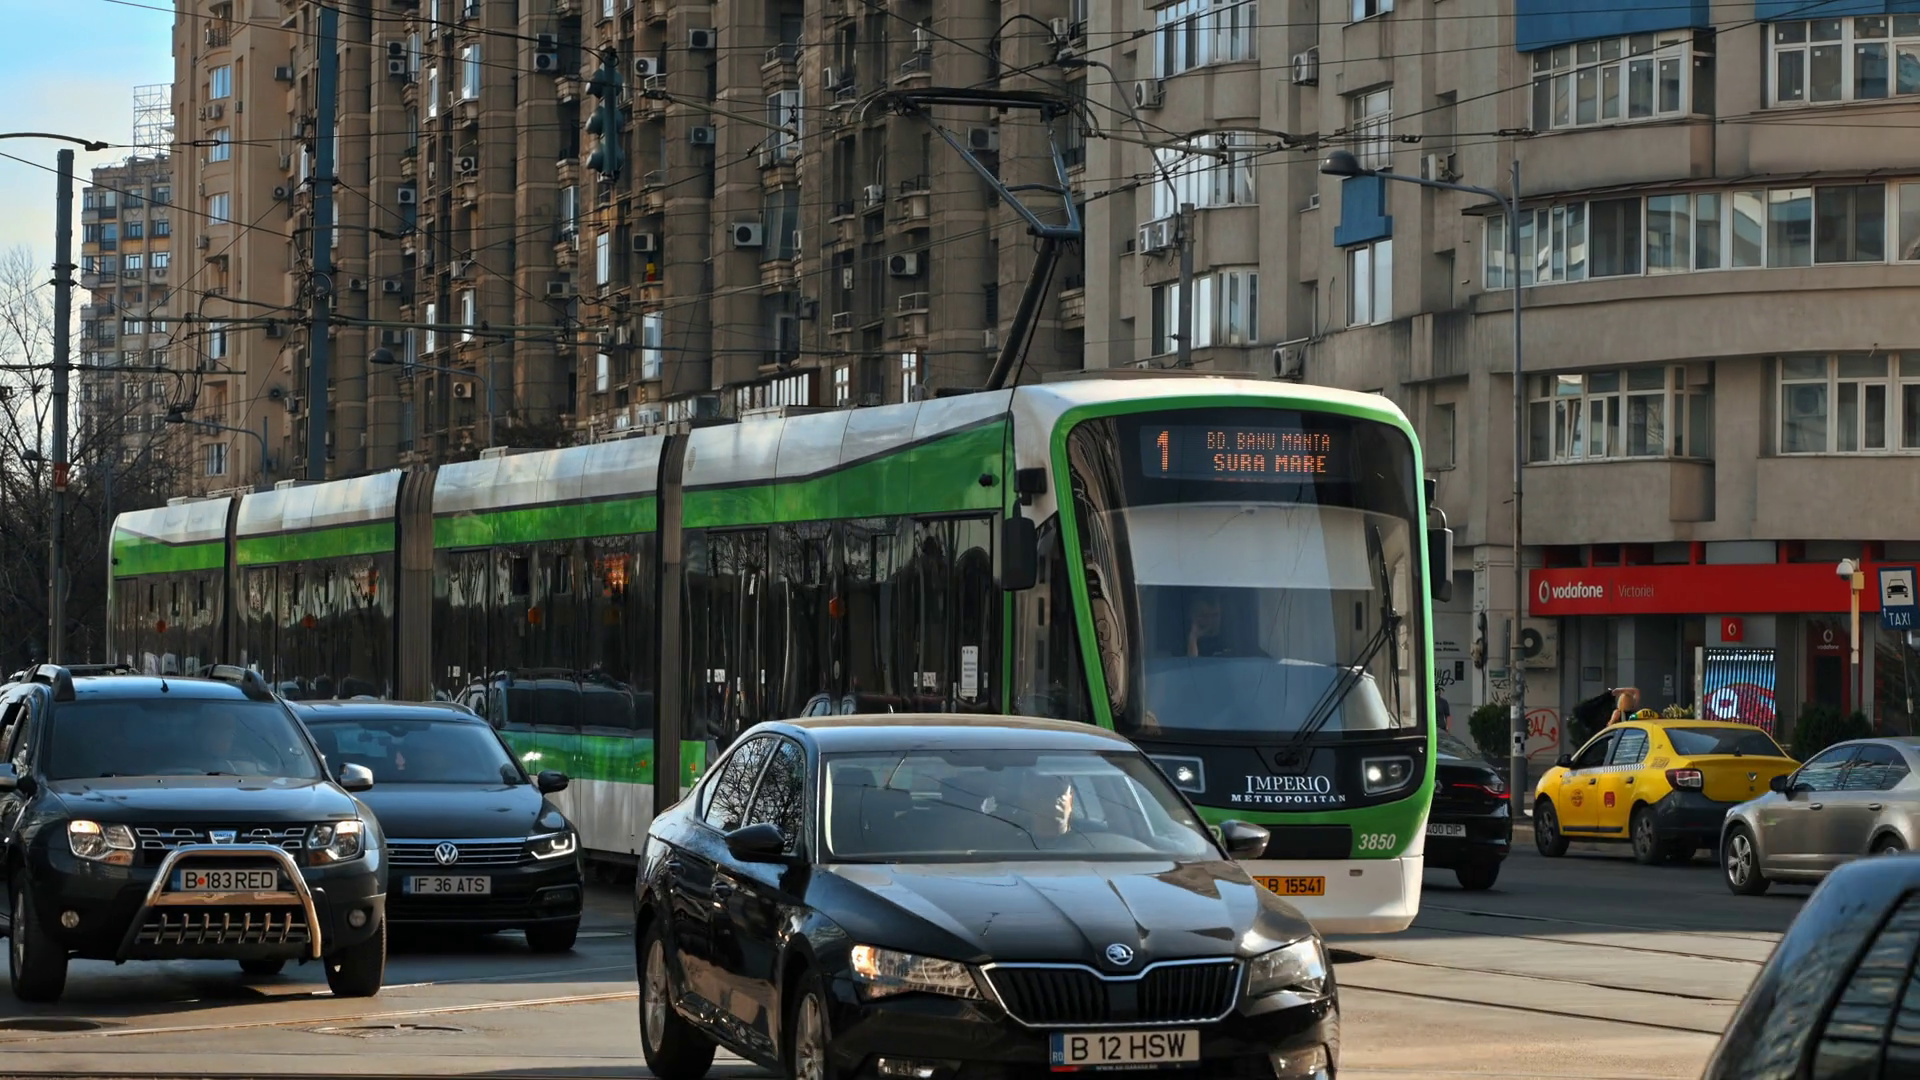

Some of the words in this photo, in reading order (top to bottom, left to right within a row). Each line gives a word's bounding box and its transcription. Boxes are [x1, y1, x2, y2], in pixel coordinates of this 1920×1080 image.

[1207, 432, 1230, 450] BD.
[1237, 432, 1276, 450] BANU
[1282, 433, 1330, 451] MANTA
[1157, 431, 1168, 472] 1
[1213, 454, 1265, 472] SURA
[1275, 455, 1326, 472] MARE
[1552, 581, 1604, 599] vodafone
[1618, 584, 1655, 598] Victoriei
[1888, 612, 1911, 626] TAXI
[1245, 775, 1330, 794] IMPERIO
[1231, 794, 1346, 803] METROPOLITAN
[1358, 833, 1397, 850] 3850
[185, 872, 198, 889] B
[205, 872, 232, 889] 183
[235, 872, 273, 889] RED
[414, 878, 429, 893] IF
[434, 878, 452, 893] 36
[457, 878, 485, 893] ATS
[1268, 878, 1279, 893] B
[1285, 878, 1322, 893] 15541
[1071, 1037, 1089, 1061] B
[1098, 1036, 1122, 1060] 12
[1129, 1033, 1186, 1059] HSW
[1052, 1051, 1064, 1062] RO
